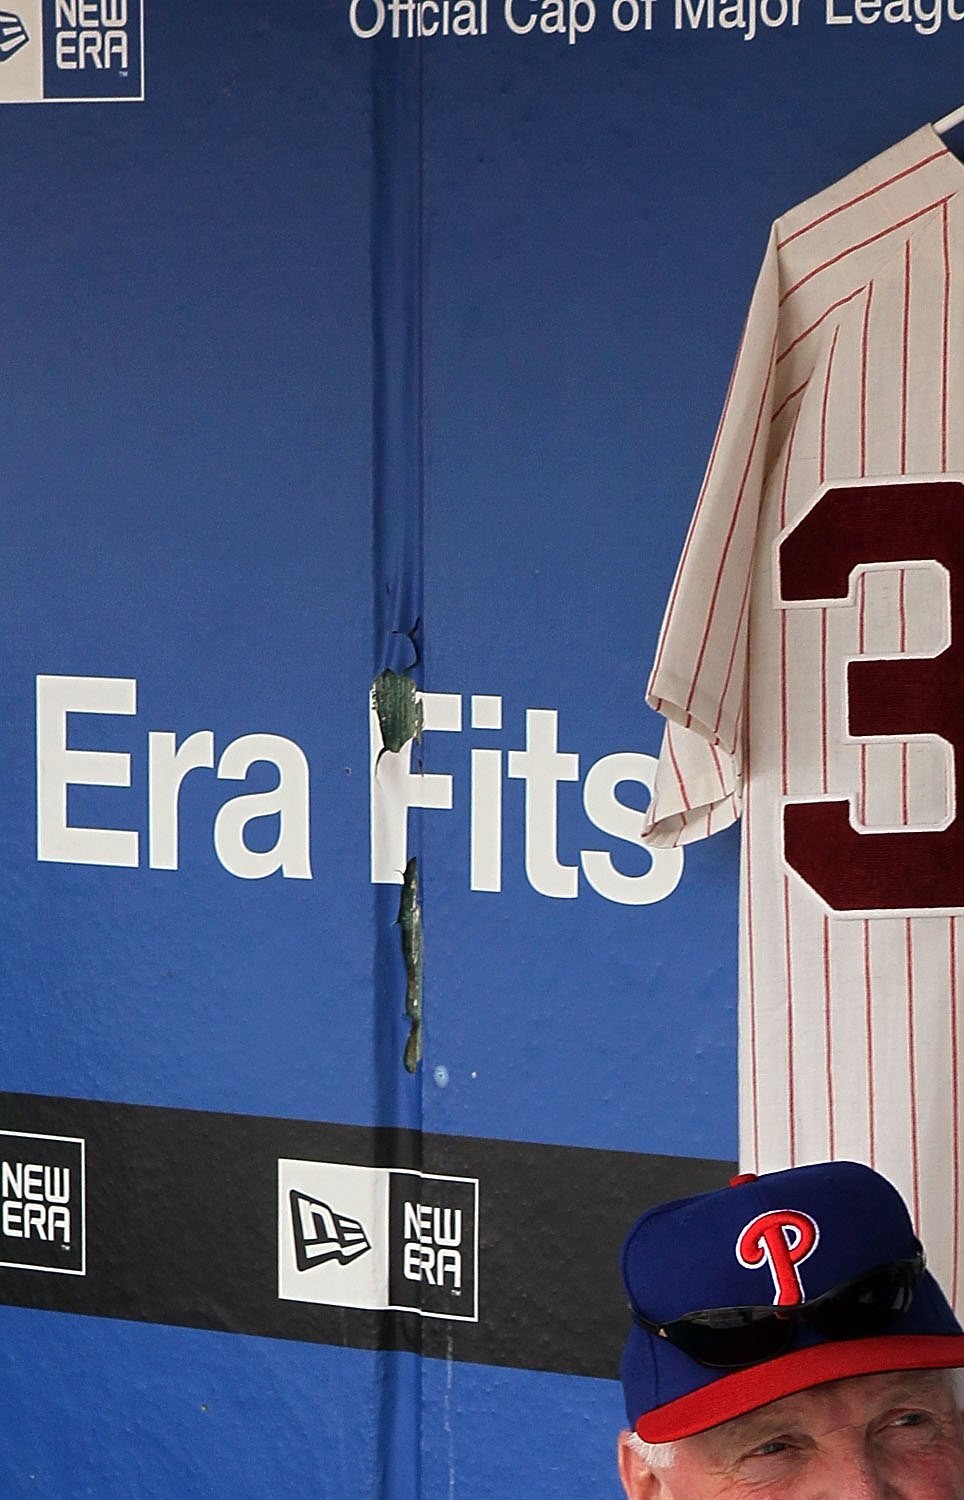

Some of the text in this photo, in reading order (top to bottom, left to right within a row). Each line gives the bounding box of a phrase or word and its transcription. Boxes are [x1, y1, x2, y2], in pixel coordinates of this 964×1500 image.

[55, 0, 128, 28] NEW
[349, 0, 488, 39] Official
[503, 0, 596, 45] Cap
[611, 0, 652, 32] of
[674, 0, 802, 41] Major
[55, 30, 128, 69] ERA
[35, 674, 685, 906] Era Fits
[1, 1161, 70, 1204] NEW
[2, 1200, 71, 1243] ERA
[403, 1201, 462, 1247] NEW
[403, 1242, 462, 1288] ERA
[735, 1208, 820, 1307] P
